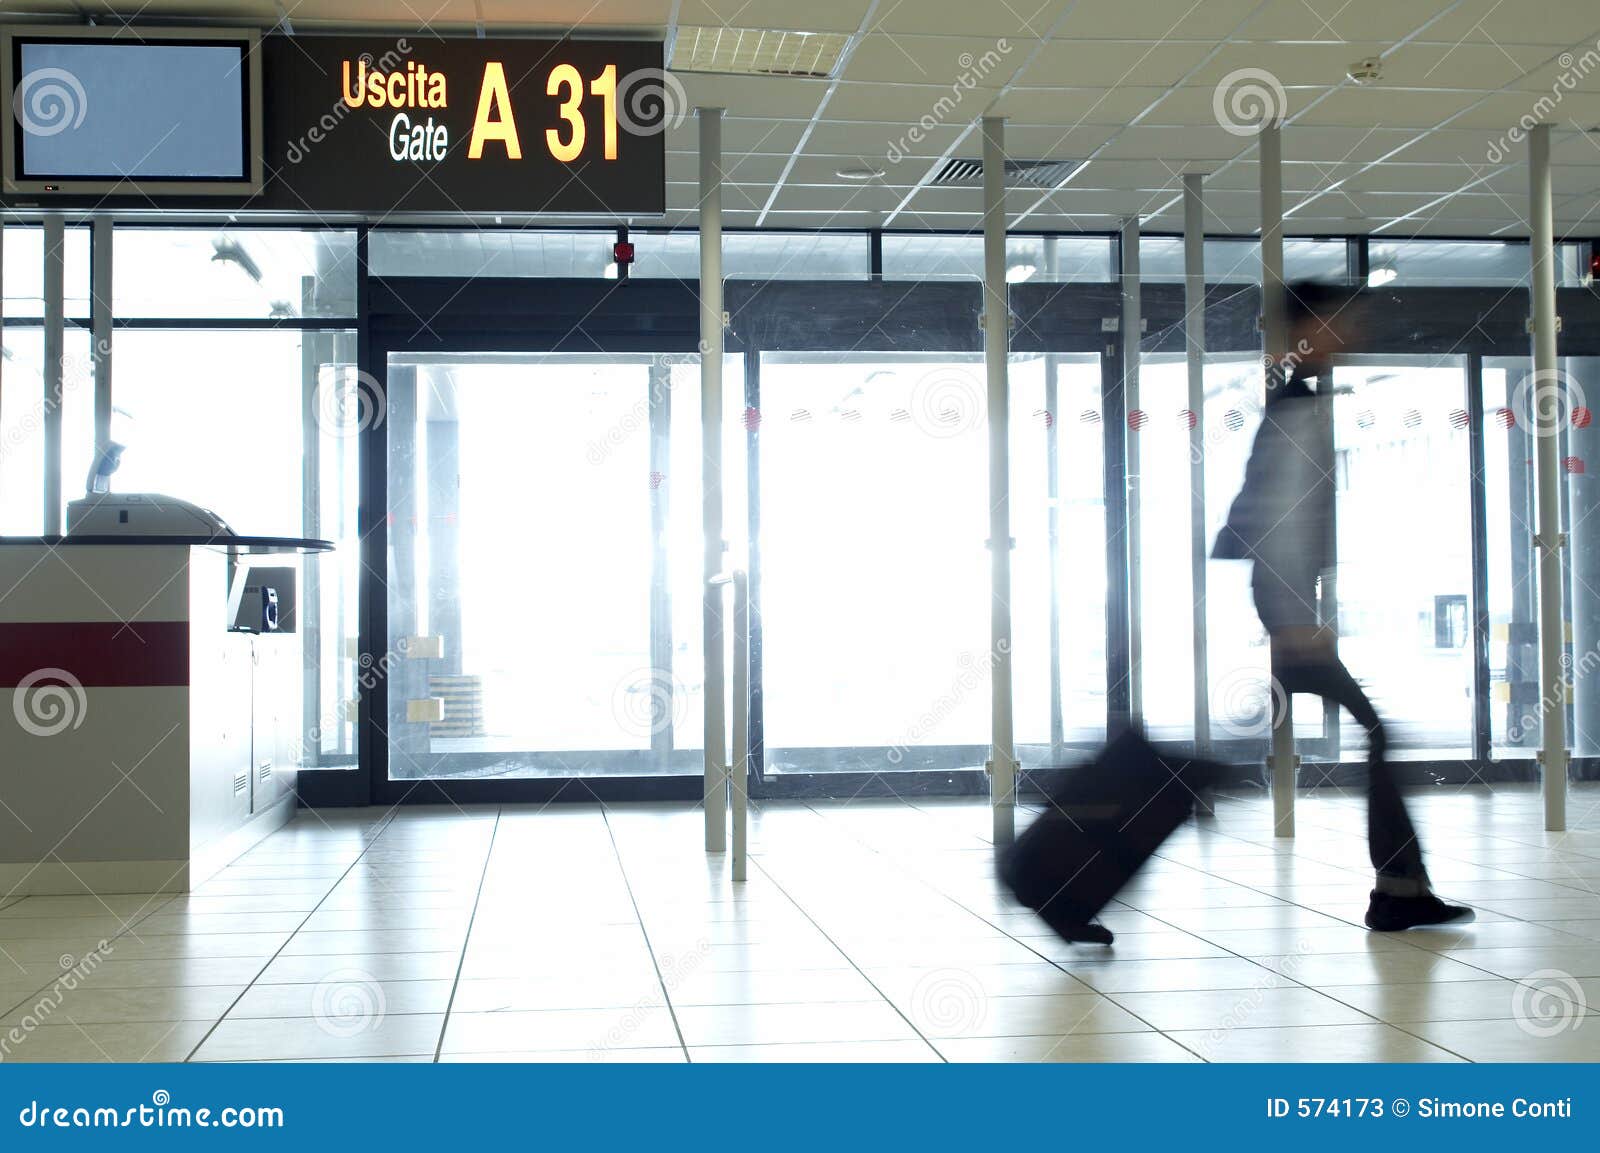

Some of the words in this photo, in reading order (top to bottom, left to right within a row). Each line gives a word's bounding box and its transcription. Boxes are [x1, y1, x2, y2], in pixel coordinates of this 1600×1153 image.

[342, 60, 448, 108] Uscita
[389, 112, 448, 161] Gate
[467, 61, 522, 160] A
[545, 63, 618, 163] 31
